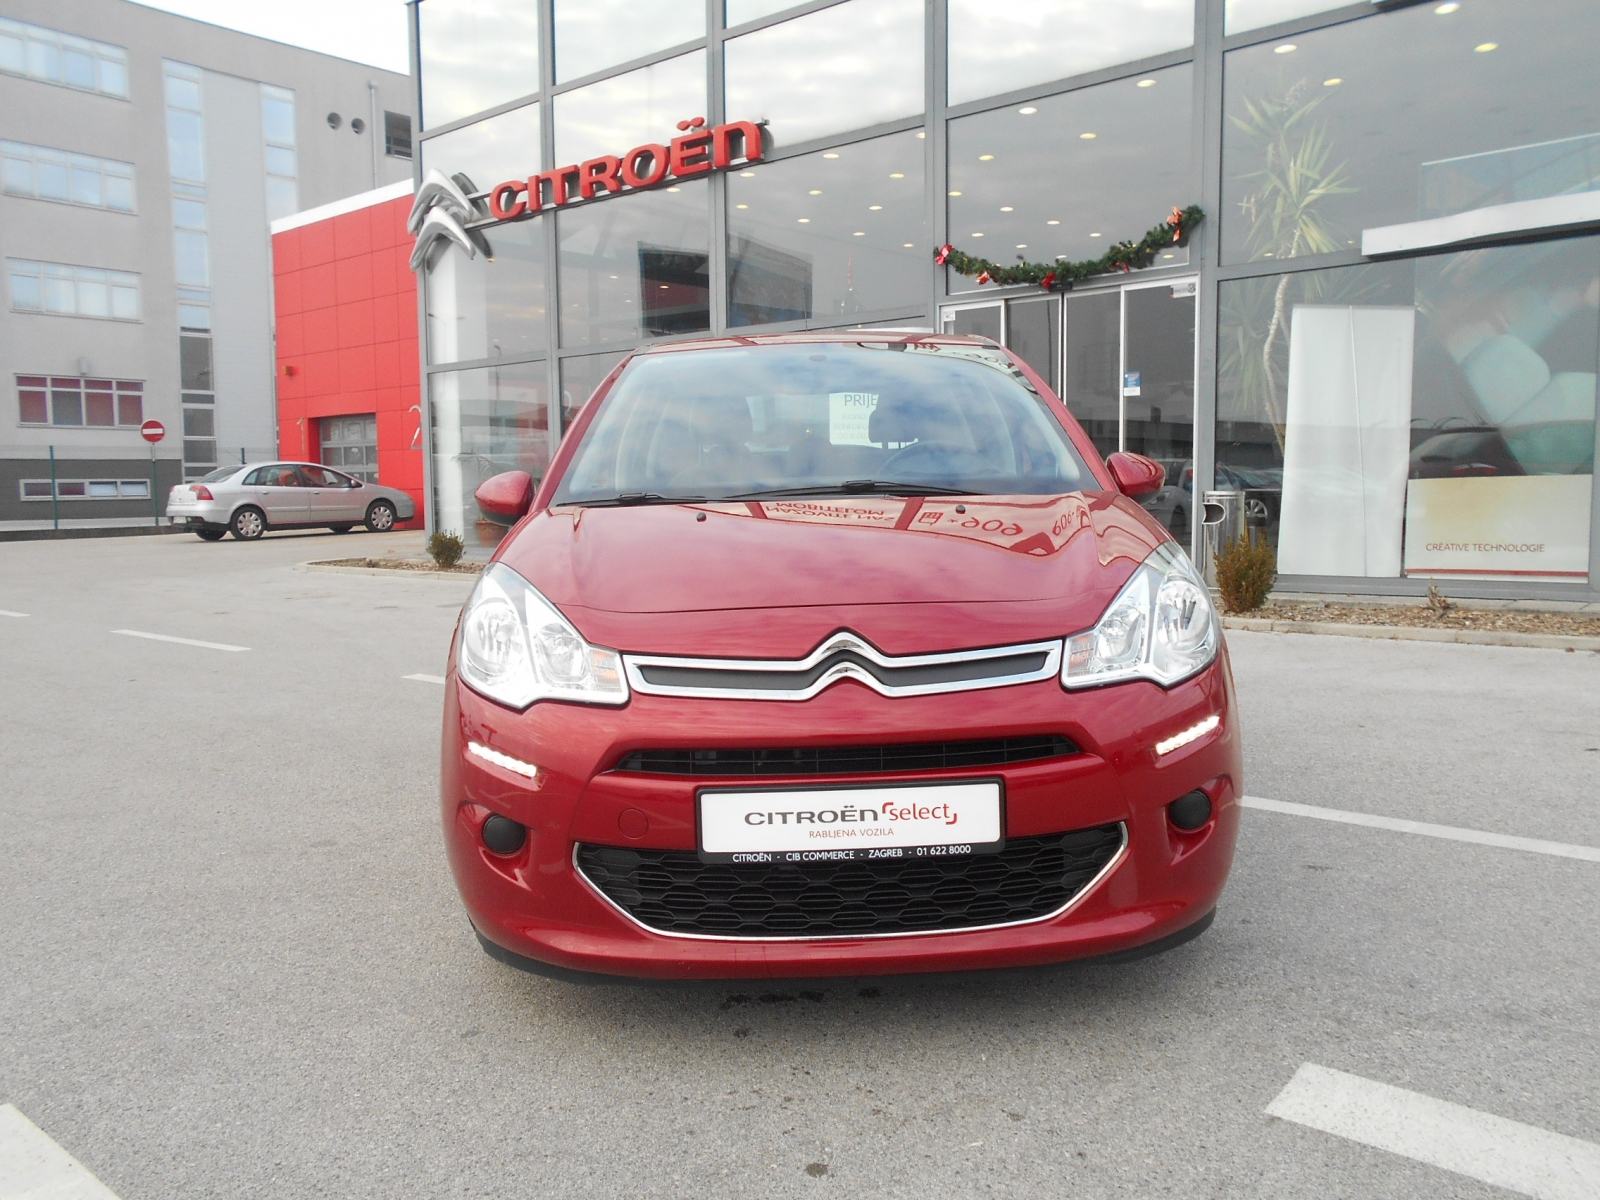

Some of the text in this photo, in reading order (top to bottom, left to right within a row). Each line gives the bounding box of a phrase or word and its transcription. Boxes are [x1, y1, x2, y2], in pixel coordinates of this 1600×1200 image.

[1472, 543, 1545, 553] TECHNOLOGIE
[809, 827, 894, 839] RABLJENA VOZILA
[732, 852, 772, 863] CITROËN
[786, 852, 801, 862] CIB
[802, 850, 855, 861] COMMERCE
[868, 848, 903, 858] ZAGREB
[916, 847, 927, 856] 01
[930, 846, 947, 856] 622
[949, 844, 971, 854] 8000
